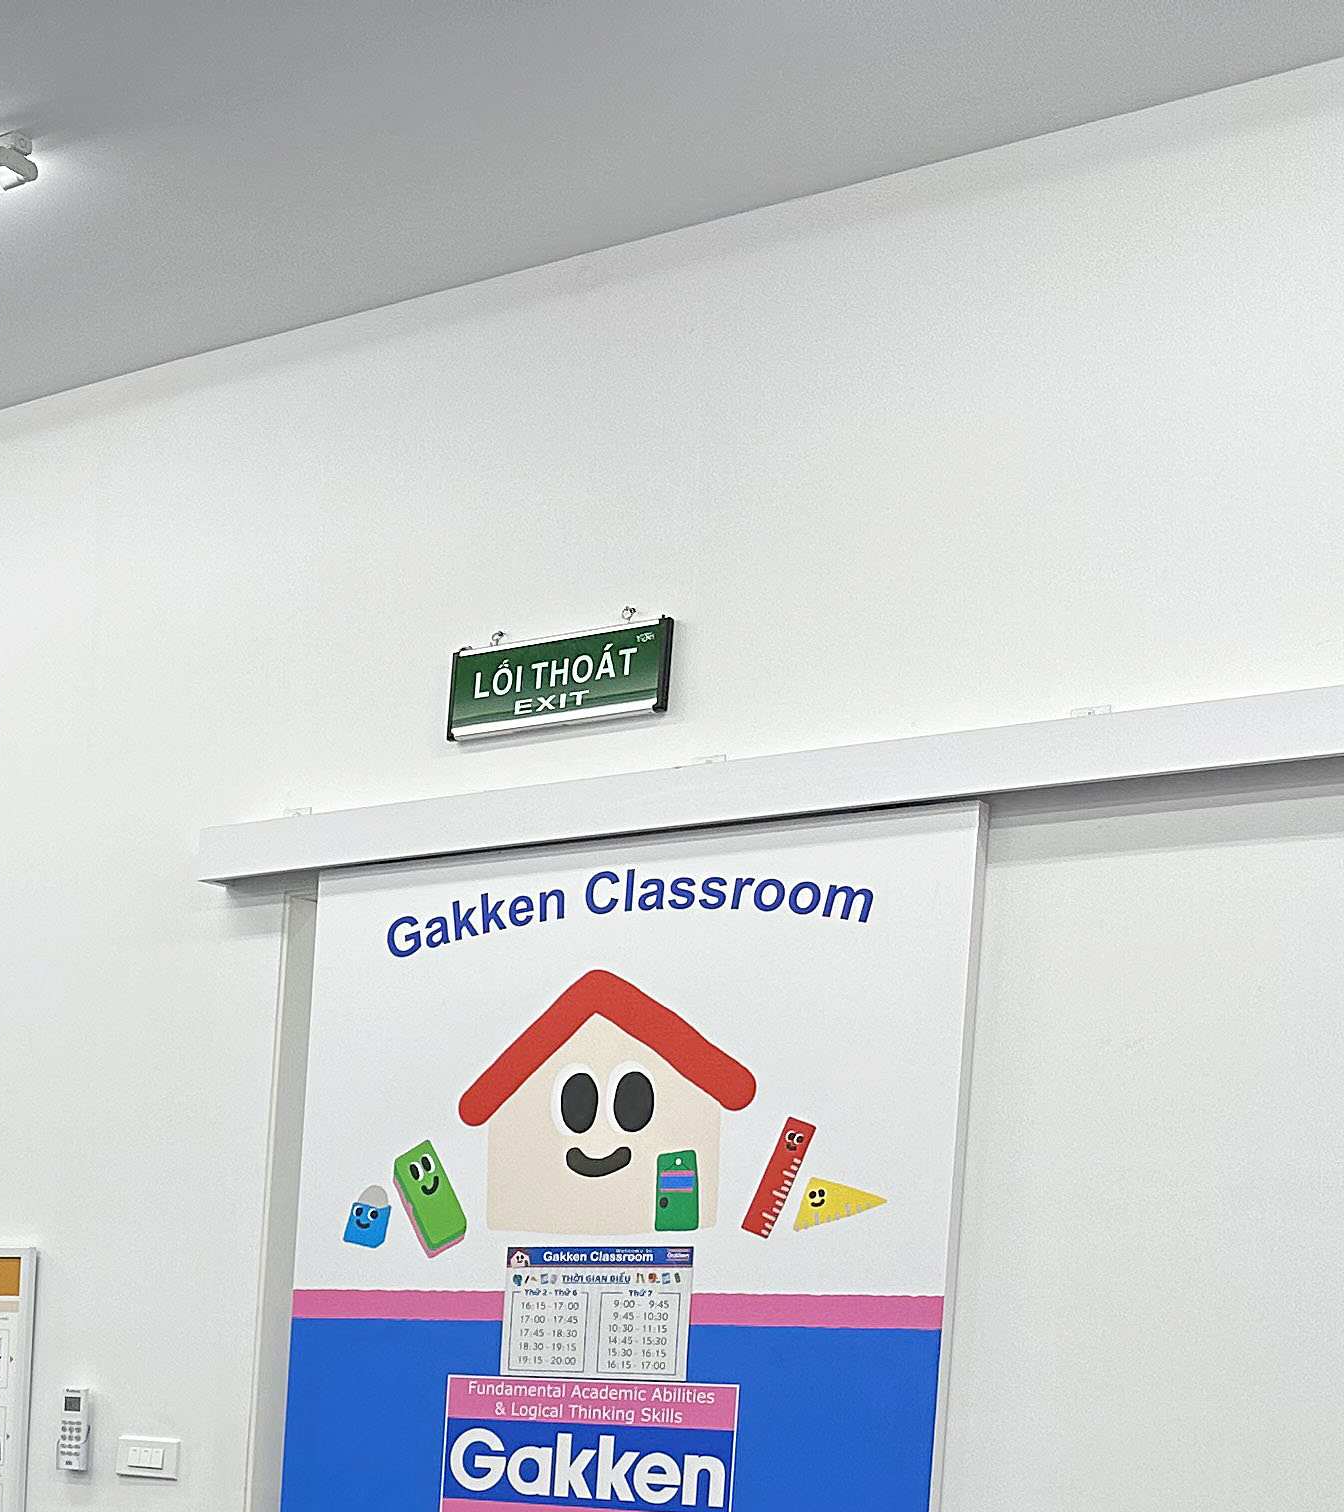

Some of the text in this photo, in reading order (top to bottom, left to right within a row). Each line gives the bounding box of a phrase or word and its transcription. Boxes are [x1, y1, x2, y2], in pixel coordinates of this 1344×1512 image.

[474, 642, 638, 700] LỐI THOÁT
[514, 689, 589, 715] EXIT
[386, 869, 875, 958] Gakken Classroom
[543, 1250, 654, 1262] Gakken Classroom
[468, 1380, 715, 1405] Fundamental Academic Abilities
[495, 1401, 683, 1425] & Logical Thinking Skills
[449, 1427, 726, 1509] Gakken
